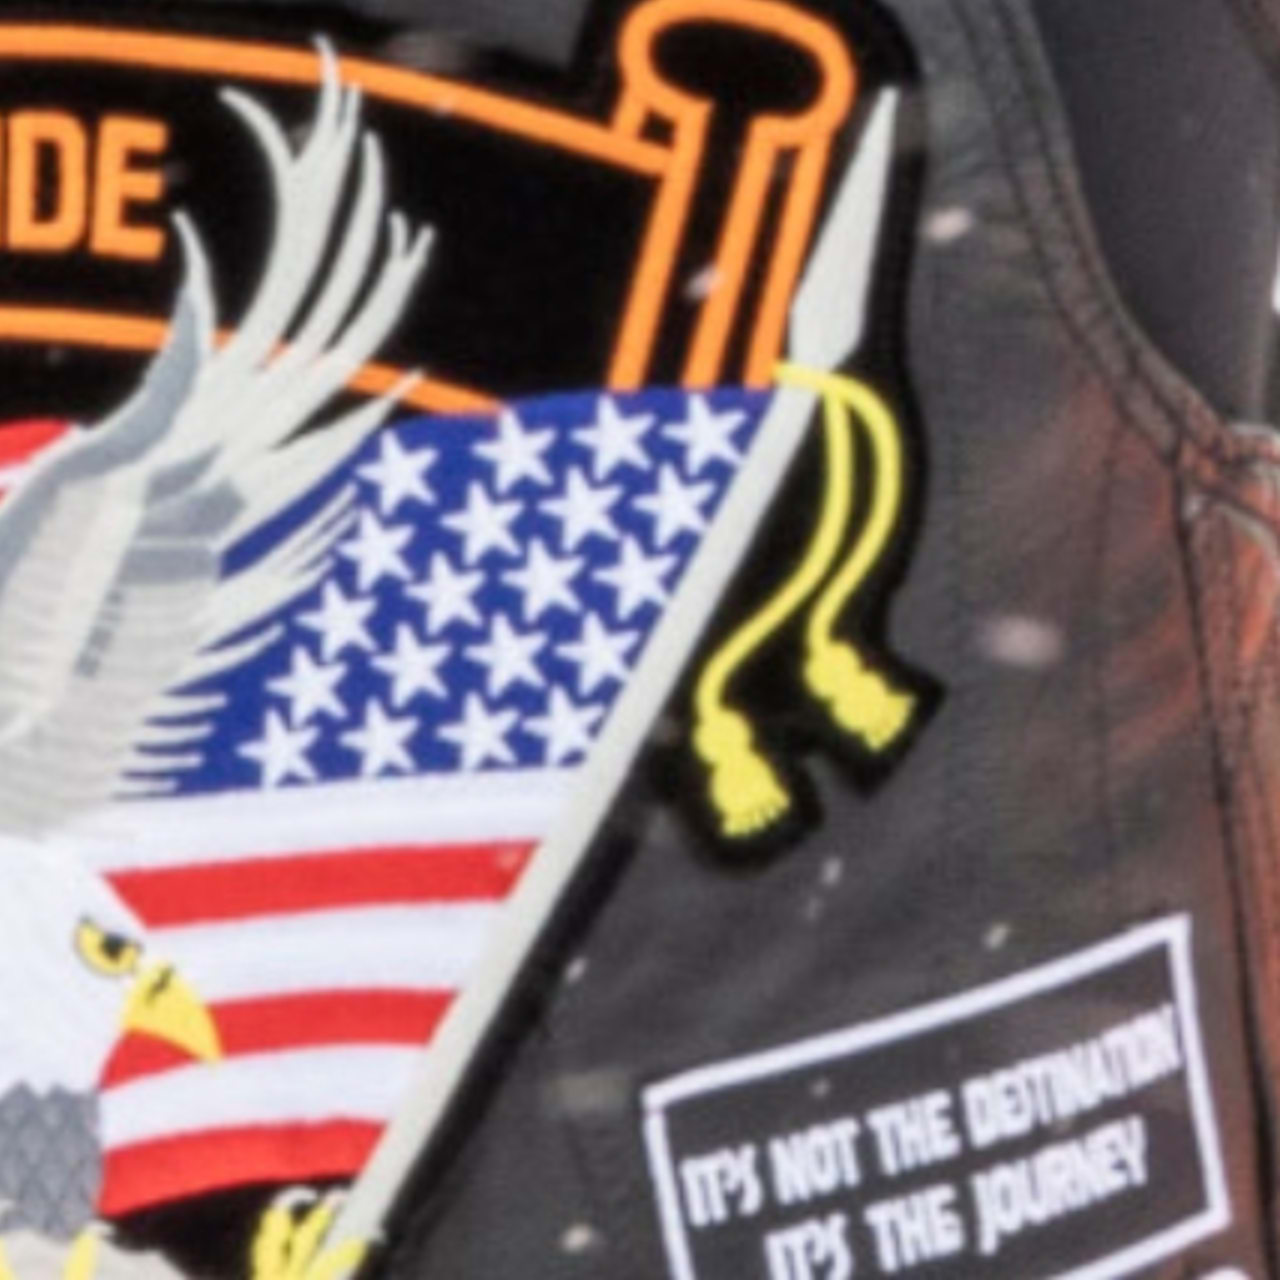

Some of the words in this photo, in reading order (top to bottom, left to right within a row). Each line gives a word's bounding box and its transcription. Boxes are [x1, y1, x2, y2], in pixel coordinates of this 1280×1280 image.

[679, 1143, 763, 1228] IT'S
[768, 1117, 860, 1204] NOT
[866, 1089, 961, 1176] THE
[962, 1002, 1181, 1149] DESTINATION
[864, 1184, 965, 1273] THE
[971, 1115, 1147, 1255] JOURNEY
